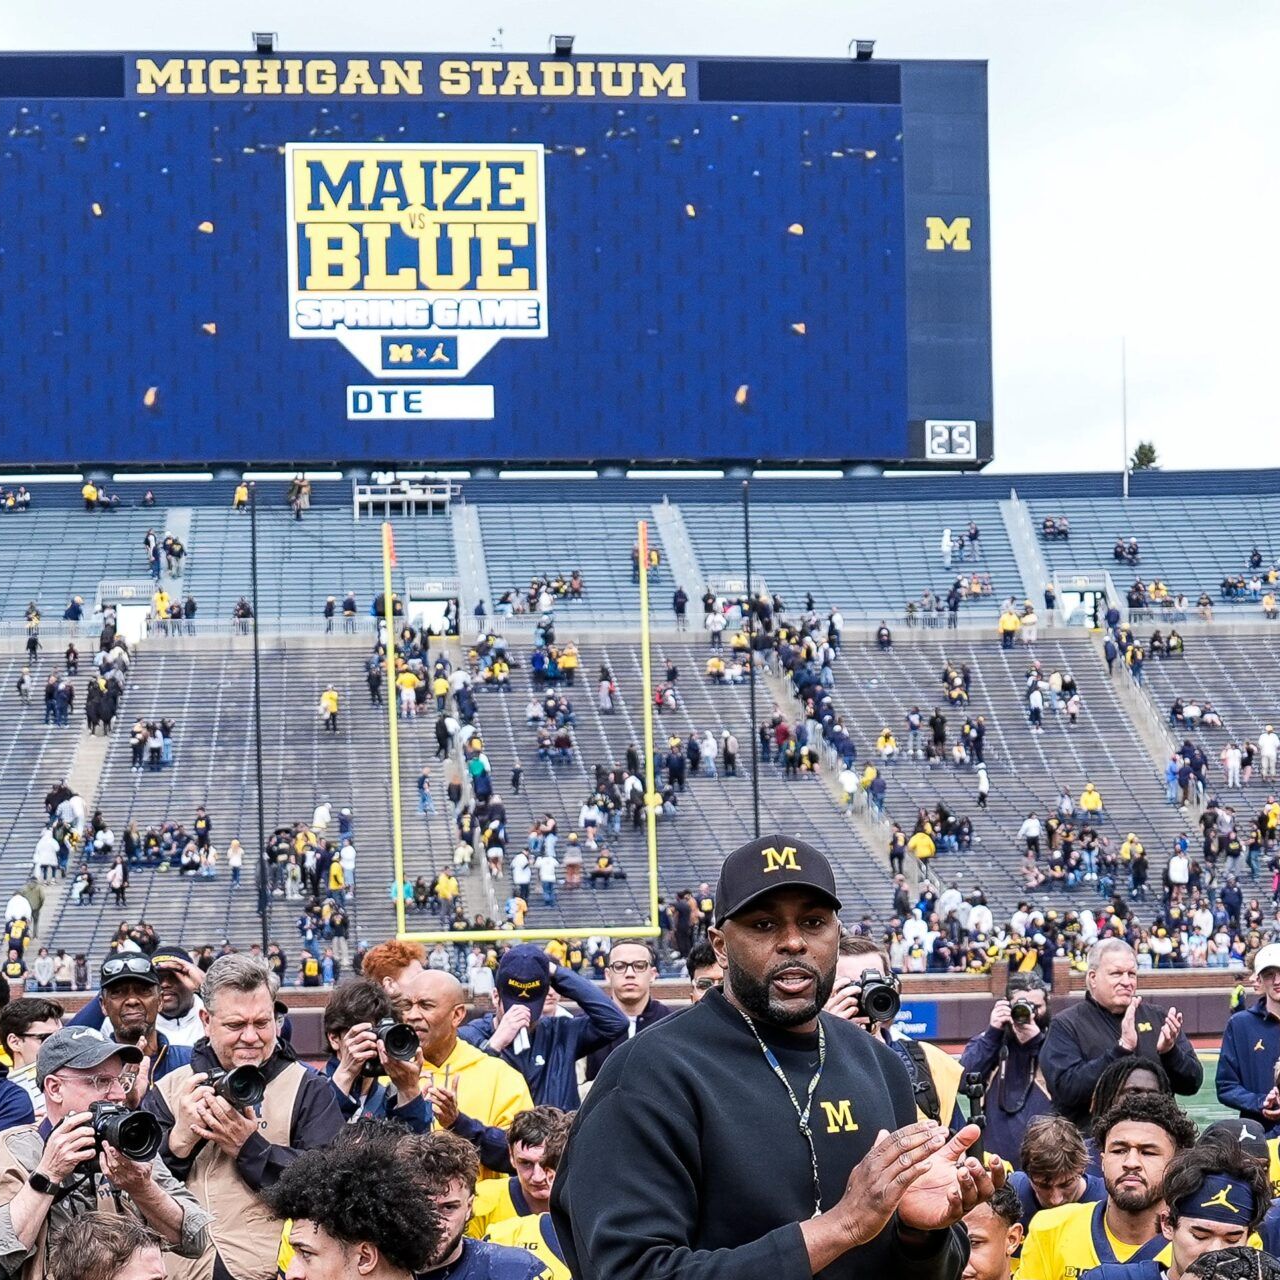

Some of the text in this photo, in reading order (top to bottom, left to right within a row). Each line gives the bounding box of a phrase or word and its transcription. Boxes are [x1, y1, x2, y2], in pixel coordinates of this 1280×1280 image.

[135, 58, 687, 97] MICHIGAN STADIUM
[306, 160, 525, 211] MAIZE
[408, 212, 426, 230] VS
[925, 216, 971, 251] M
[305, 222, 529, 290] BLUE
[296, 299, 540, 330] SPRING GAME
[352, 390, 423, 414] DTE
[930, 424, 971, 455] 25
[761, 846, 802, 873] M
[821, 1100, 859, 1134] M
